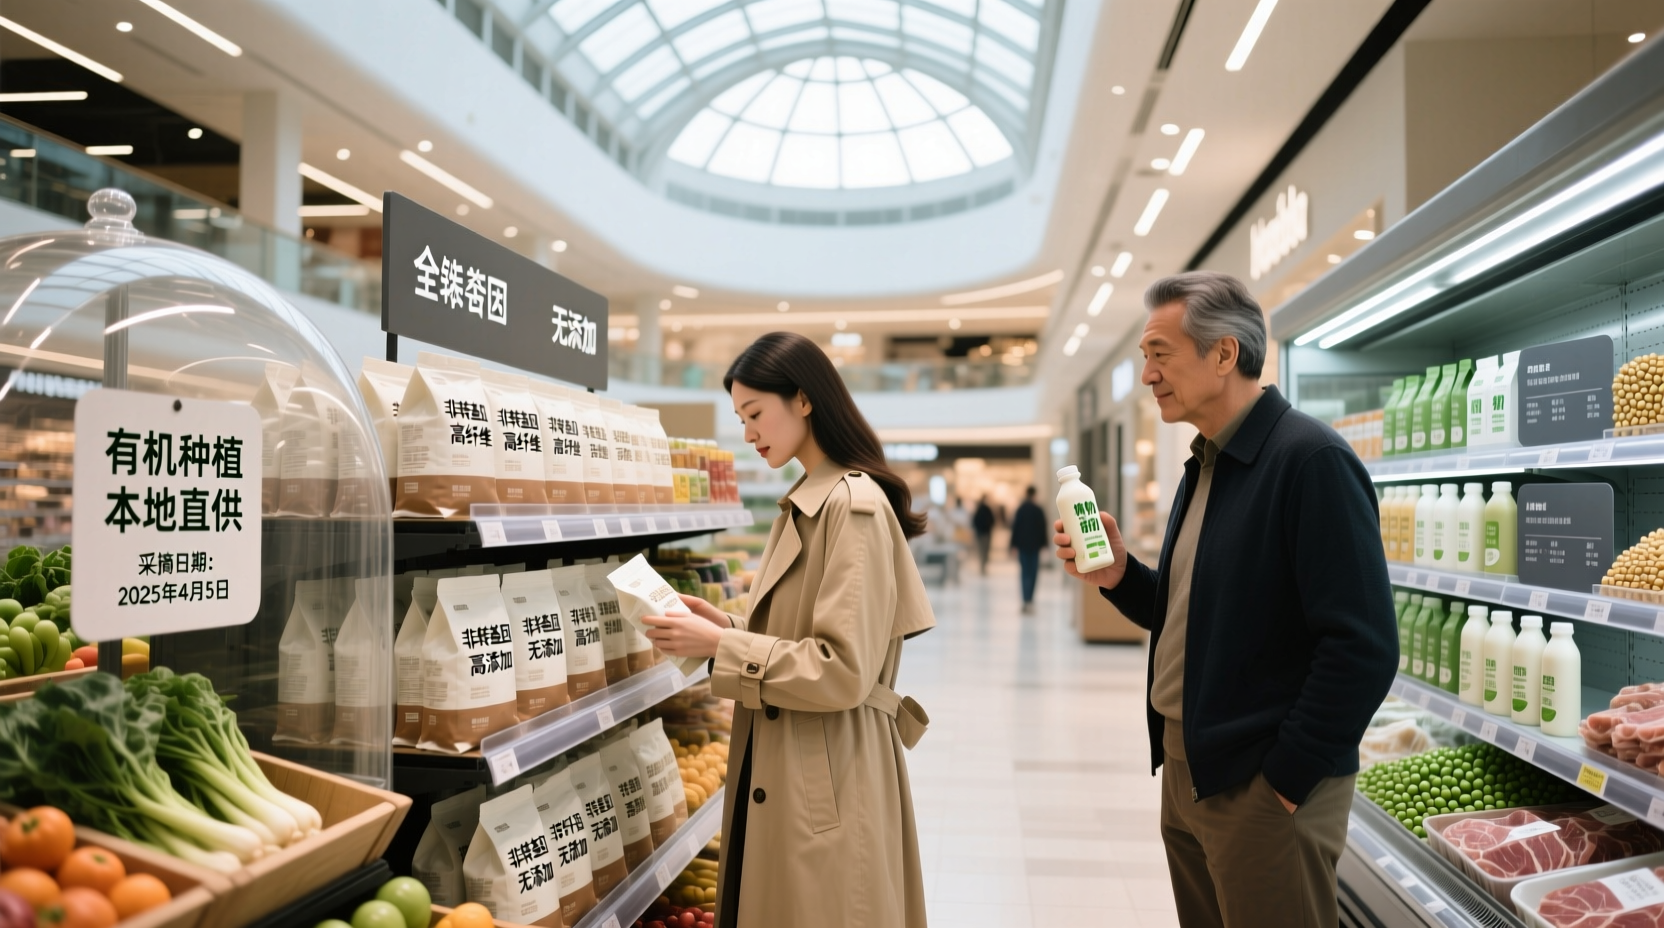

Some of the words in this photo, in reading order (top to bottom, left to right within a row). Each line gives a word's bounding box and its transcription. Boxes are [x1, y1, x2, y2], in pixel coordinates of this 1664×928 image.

[551, 304, 597, 355] 无添加
[105, 427, 244, 479] 有机种植
[104, 485, 243, 534] 本地直供
[118, 579, 229, 607] 2025年4月5日
